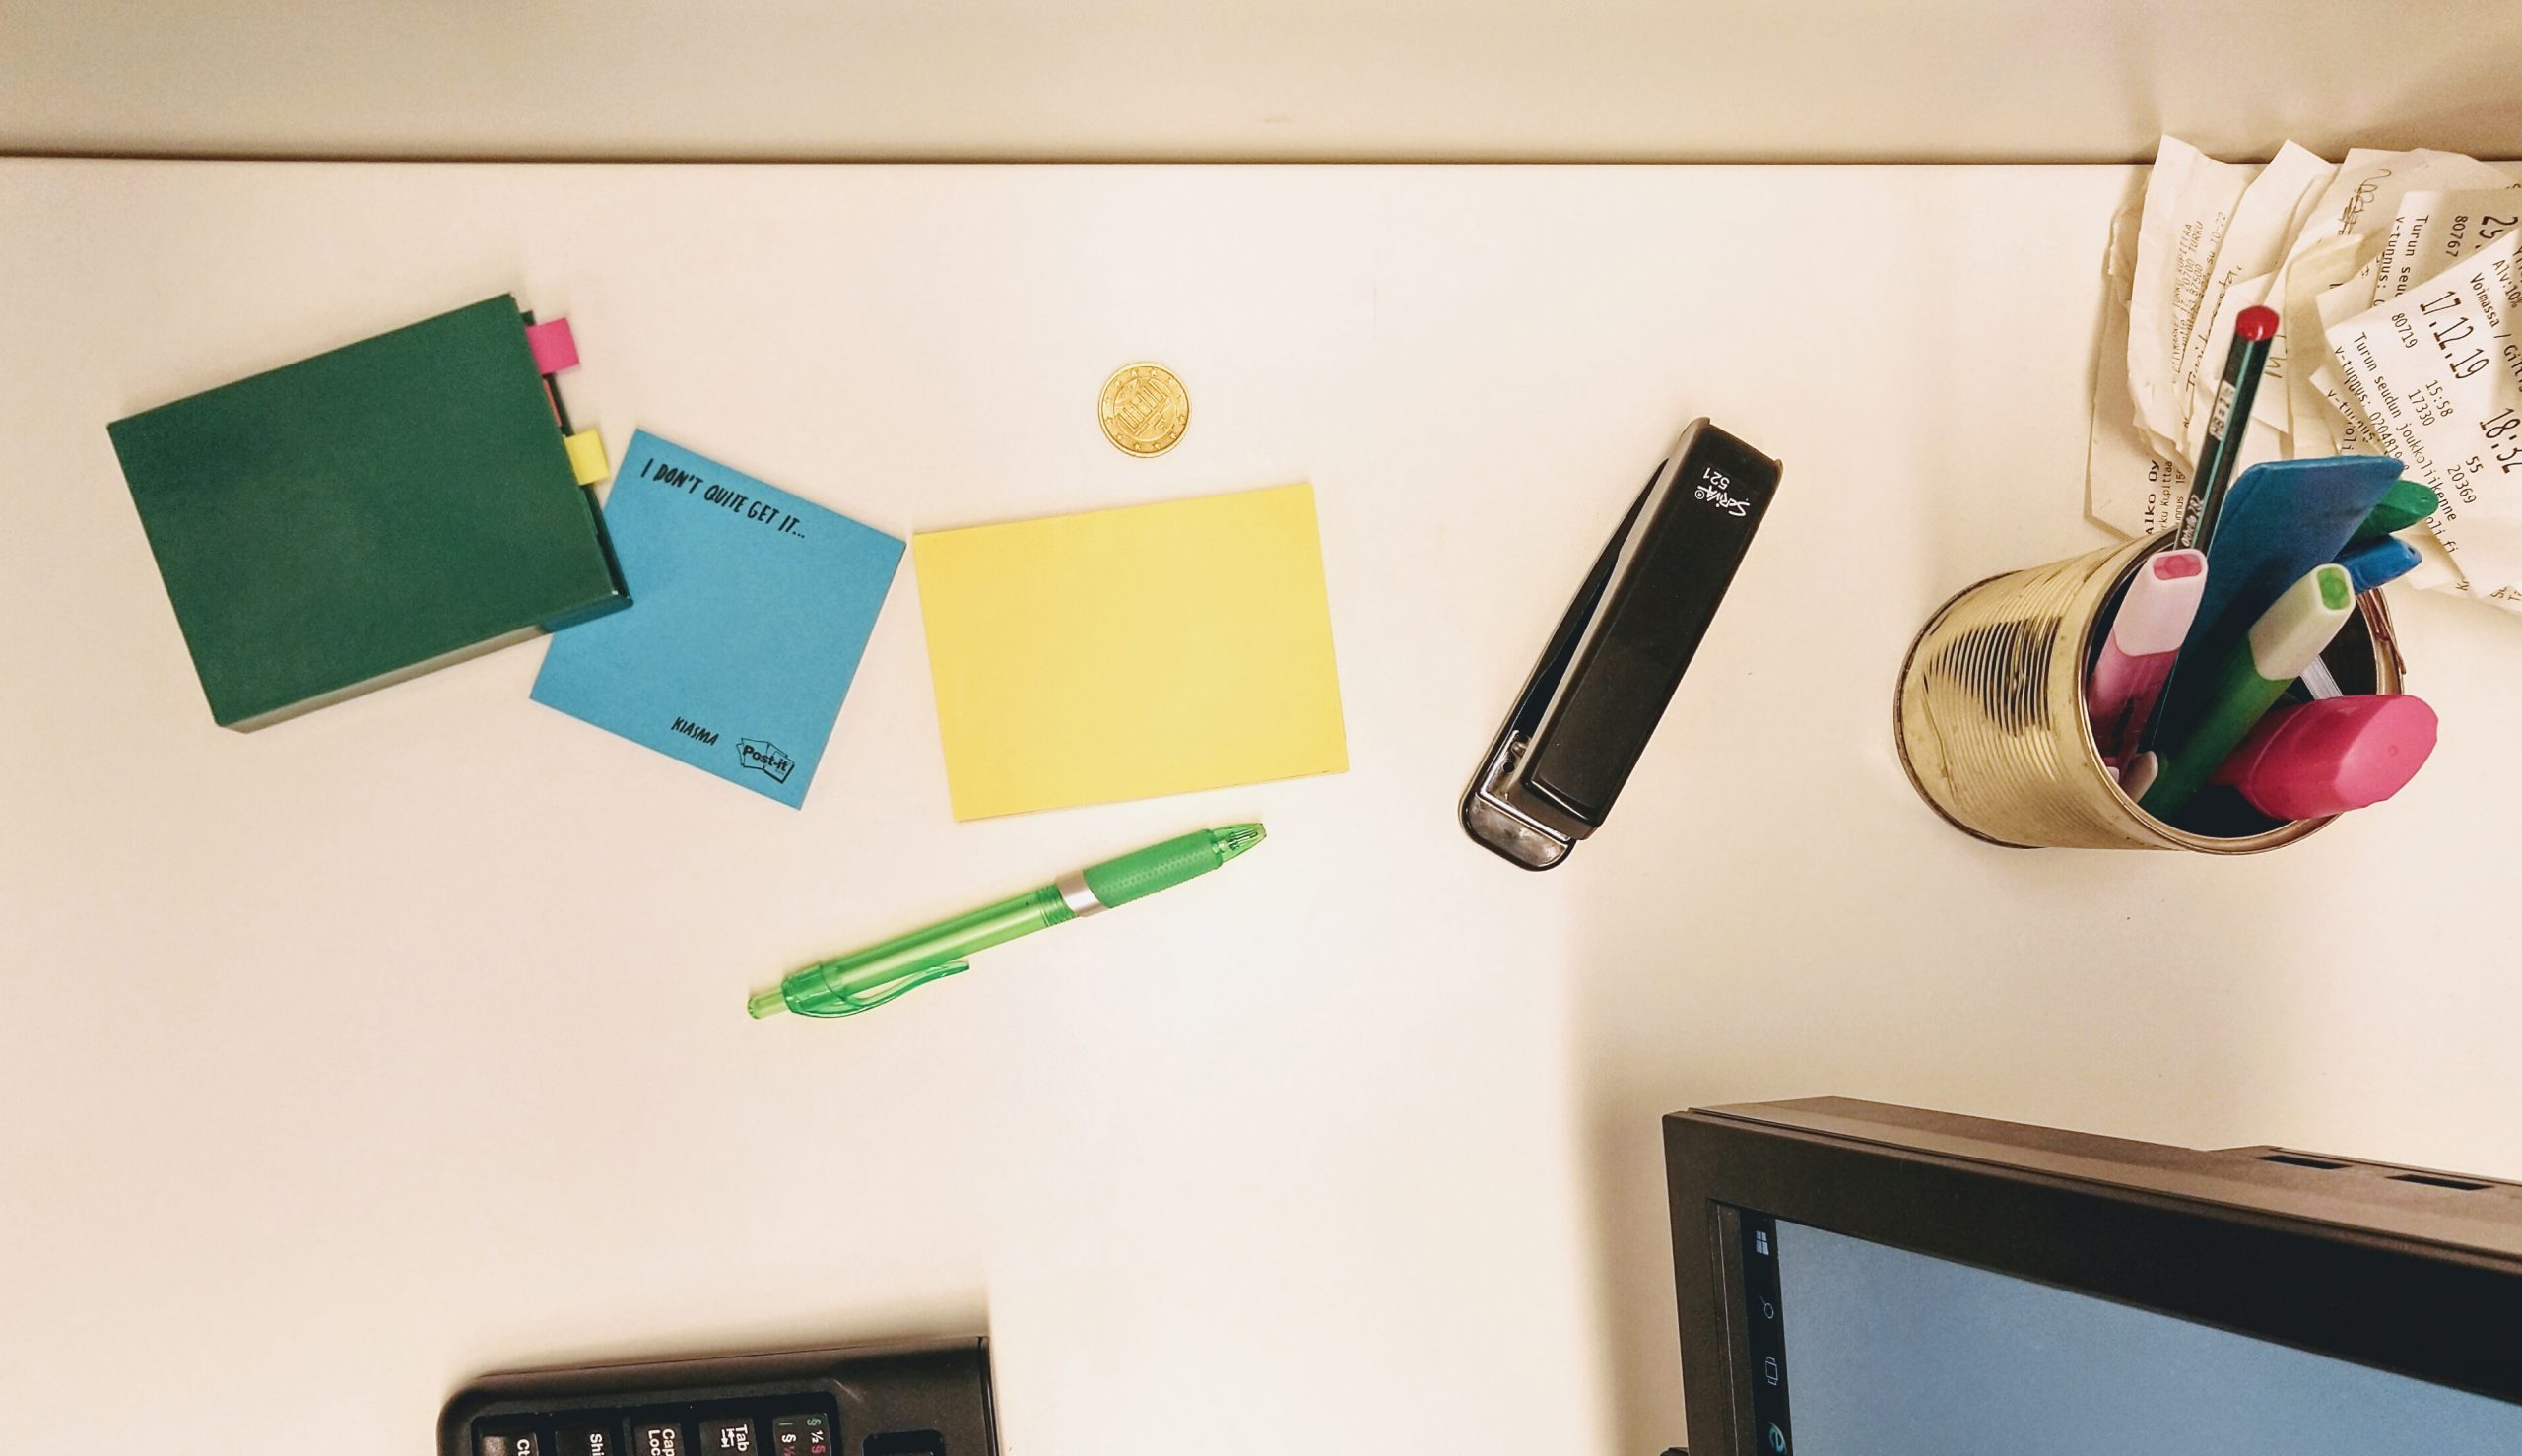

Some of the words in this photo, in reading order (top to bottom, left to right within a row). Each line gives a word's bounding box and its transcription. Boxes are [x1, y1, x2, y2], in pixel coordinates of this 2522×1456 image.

[2188, 221, 2204, 253] TURKU
[2405, 215, 2429, 257] Turun
[2446, 215, 2469, 257] 80767
[2470, 272, 2500, 328] Voimassa
[2391, 313, 2419, 349] 80719
[2420, 291, 2489, 379] 17.12.19
[2354, 331, 2377, 372] Turun
[2374, 375, 2402, 419] seudun
[2396, 422, 2457, 521] joukkoliikenne
[2409, 389, 2435, 427] 17330
[2447, 464, 2477, 504] 20369
[2425, 380, 2453, 417] 15:58
[2465, 455, 2484, 474] 55
[641, 457, 654, 478] I
[652, 463, 703, 494] DON'T
[703, 484, 749, 513] QUITE
[747, 500, 780, 524] GET
[1702, 467, 1730, 490] 521
[2148, 459, 2160, 482] Oy
[2160, 461, 2173, 507] Kupittaa
[671, 716, 719, 746] KIASMA
[742, 744, 787, 772] Post-it
[735, 1423, 750, 1452] Tab
